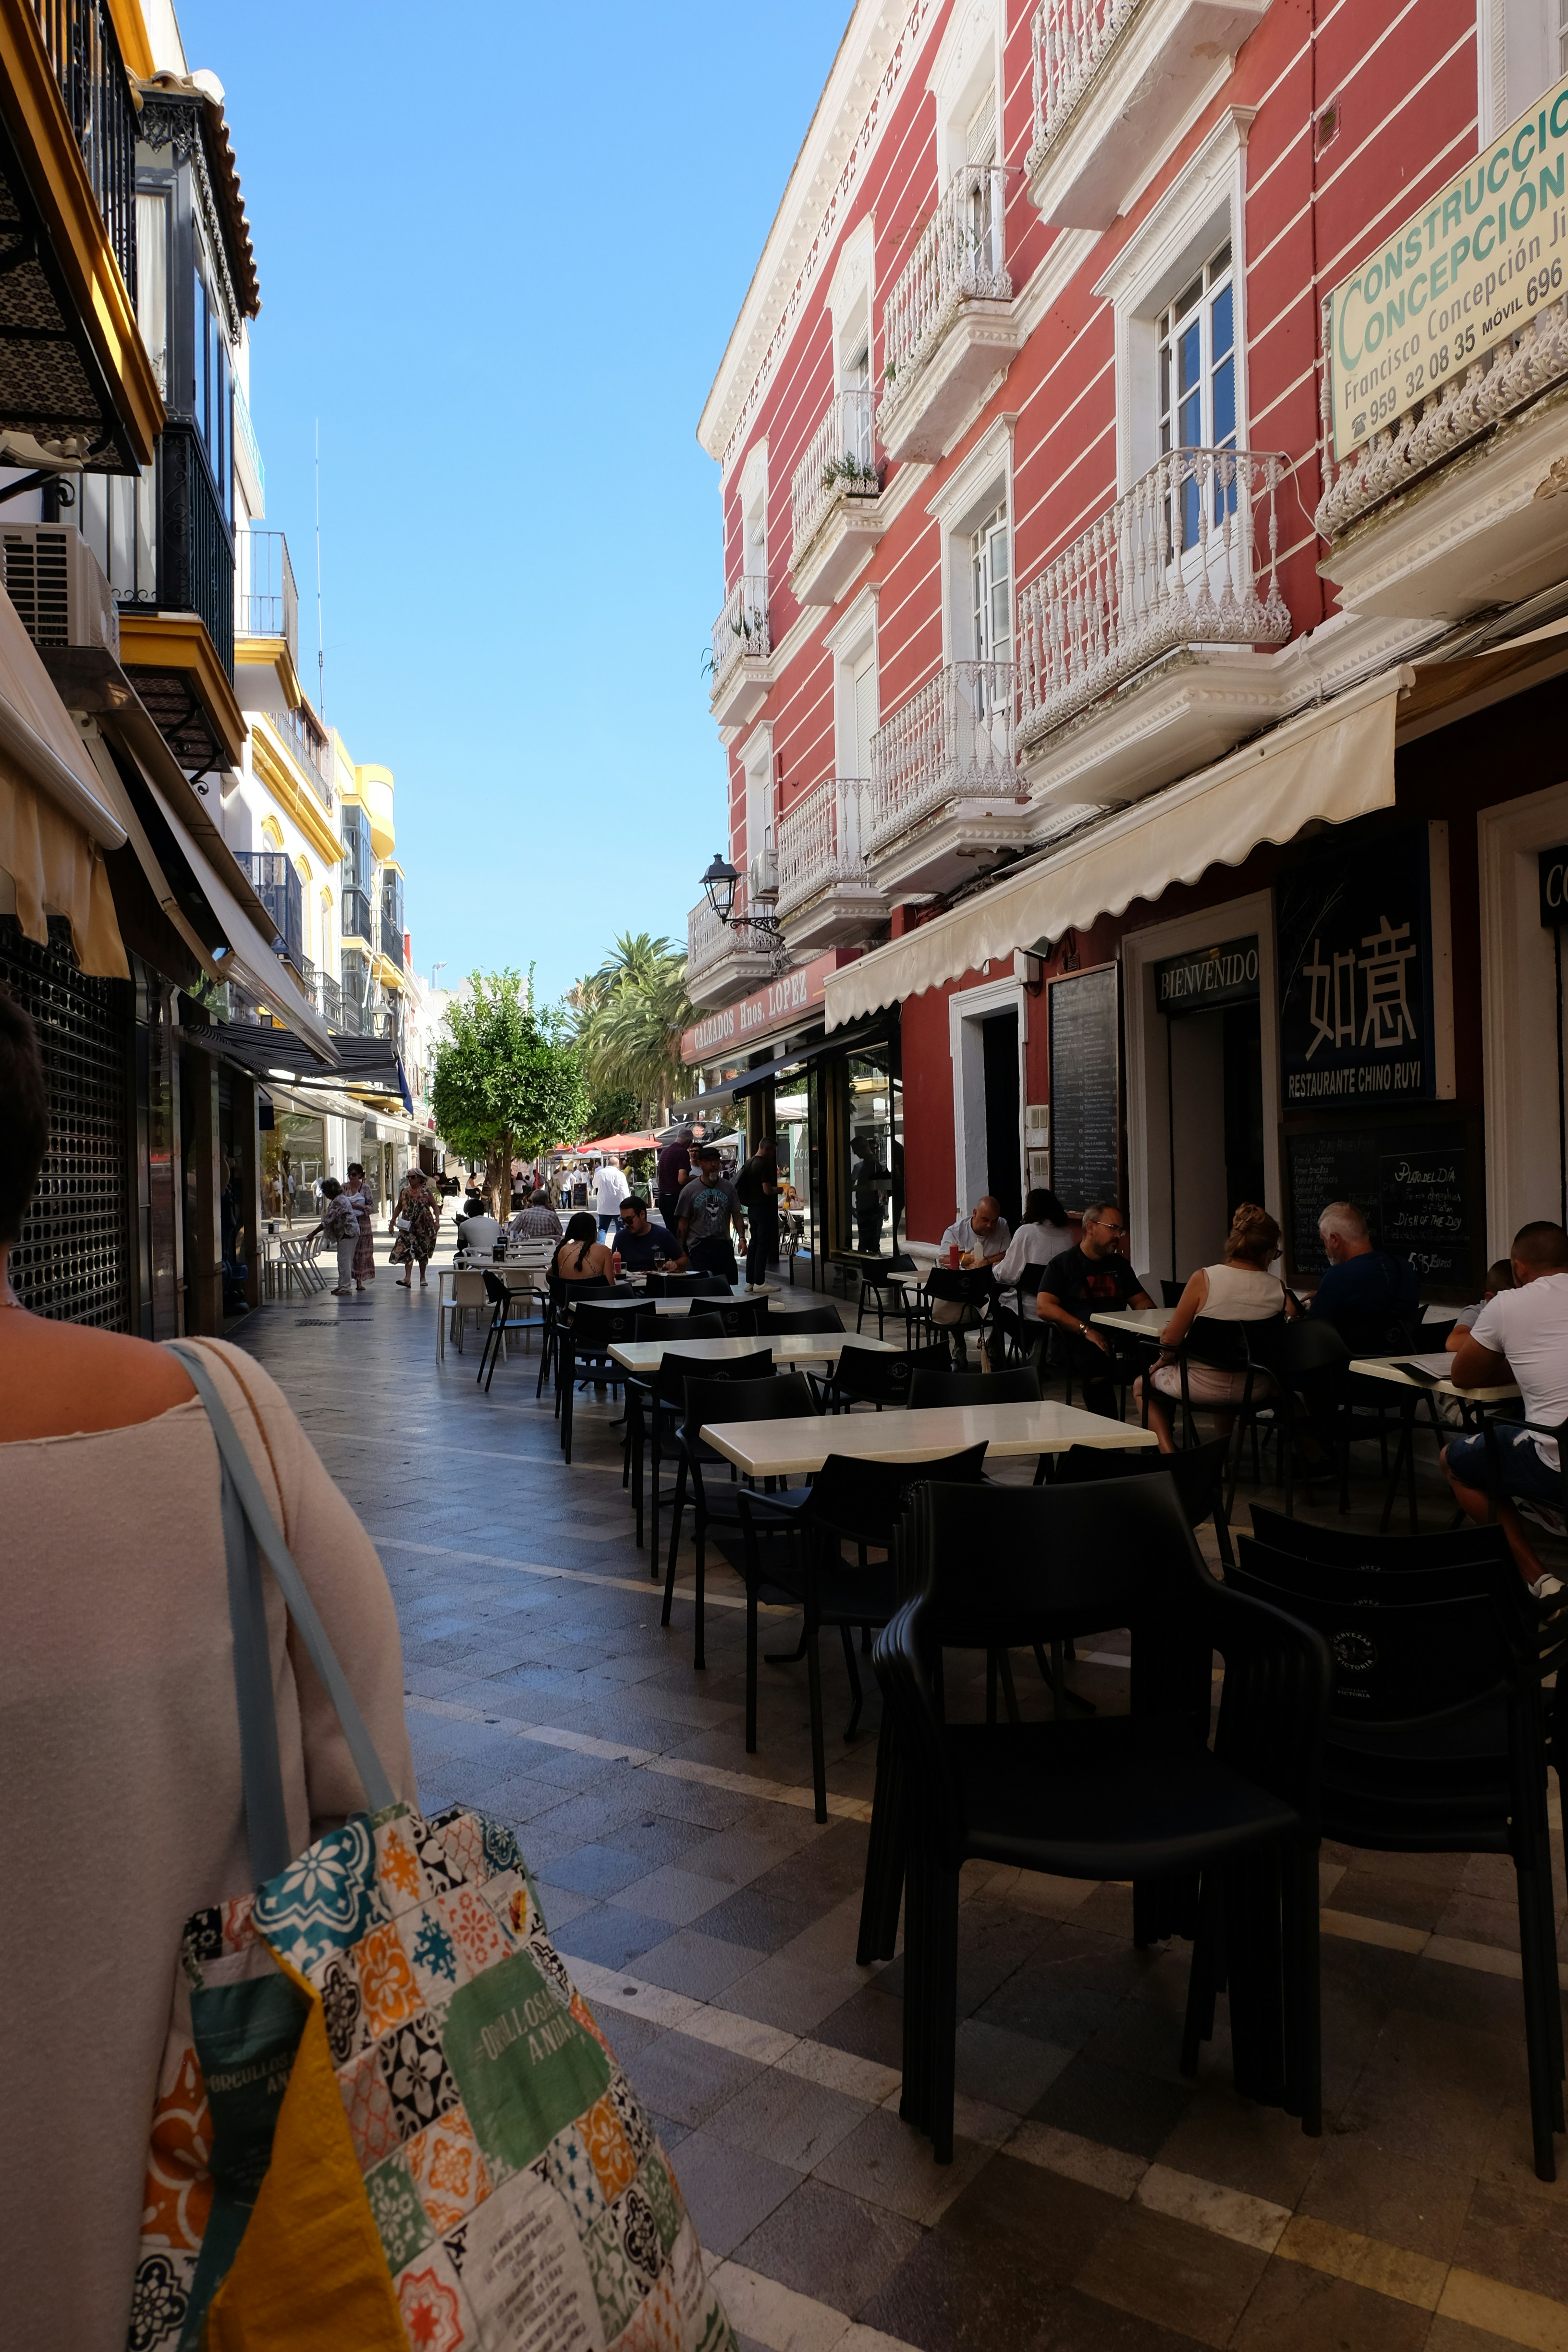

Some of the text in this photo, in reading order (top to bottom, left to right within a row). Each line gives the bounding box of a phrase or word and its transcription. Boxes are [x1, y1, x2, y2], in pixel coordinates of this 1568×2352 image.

[1345, 333, 1420, 410] Francisco
[1428, 234, 1540, 341] Concepción
[1370, 257, 1563, 426] 959 32 08 35 MÓVIL 696
[1160, 949, 1258, 1001] BIENVENIDO
[1302, 914, 1417, 1062] 如意
[695, 969, 808, 1052] CALZADOS Hnos. LOPEZ
[1288, 1060, 1421, 1099] RESTAURANTE CHINO RUYI
[1408, 1252, 1430, 1274] 5.95
[1333, 1631, 1372, 1647] CERVEZAS
[1336, 1656, 1373, 1671] VICTORIA
[1337, 1689, 1371, 1699] VICTORIA
